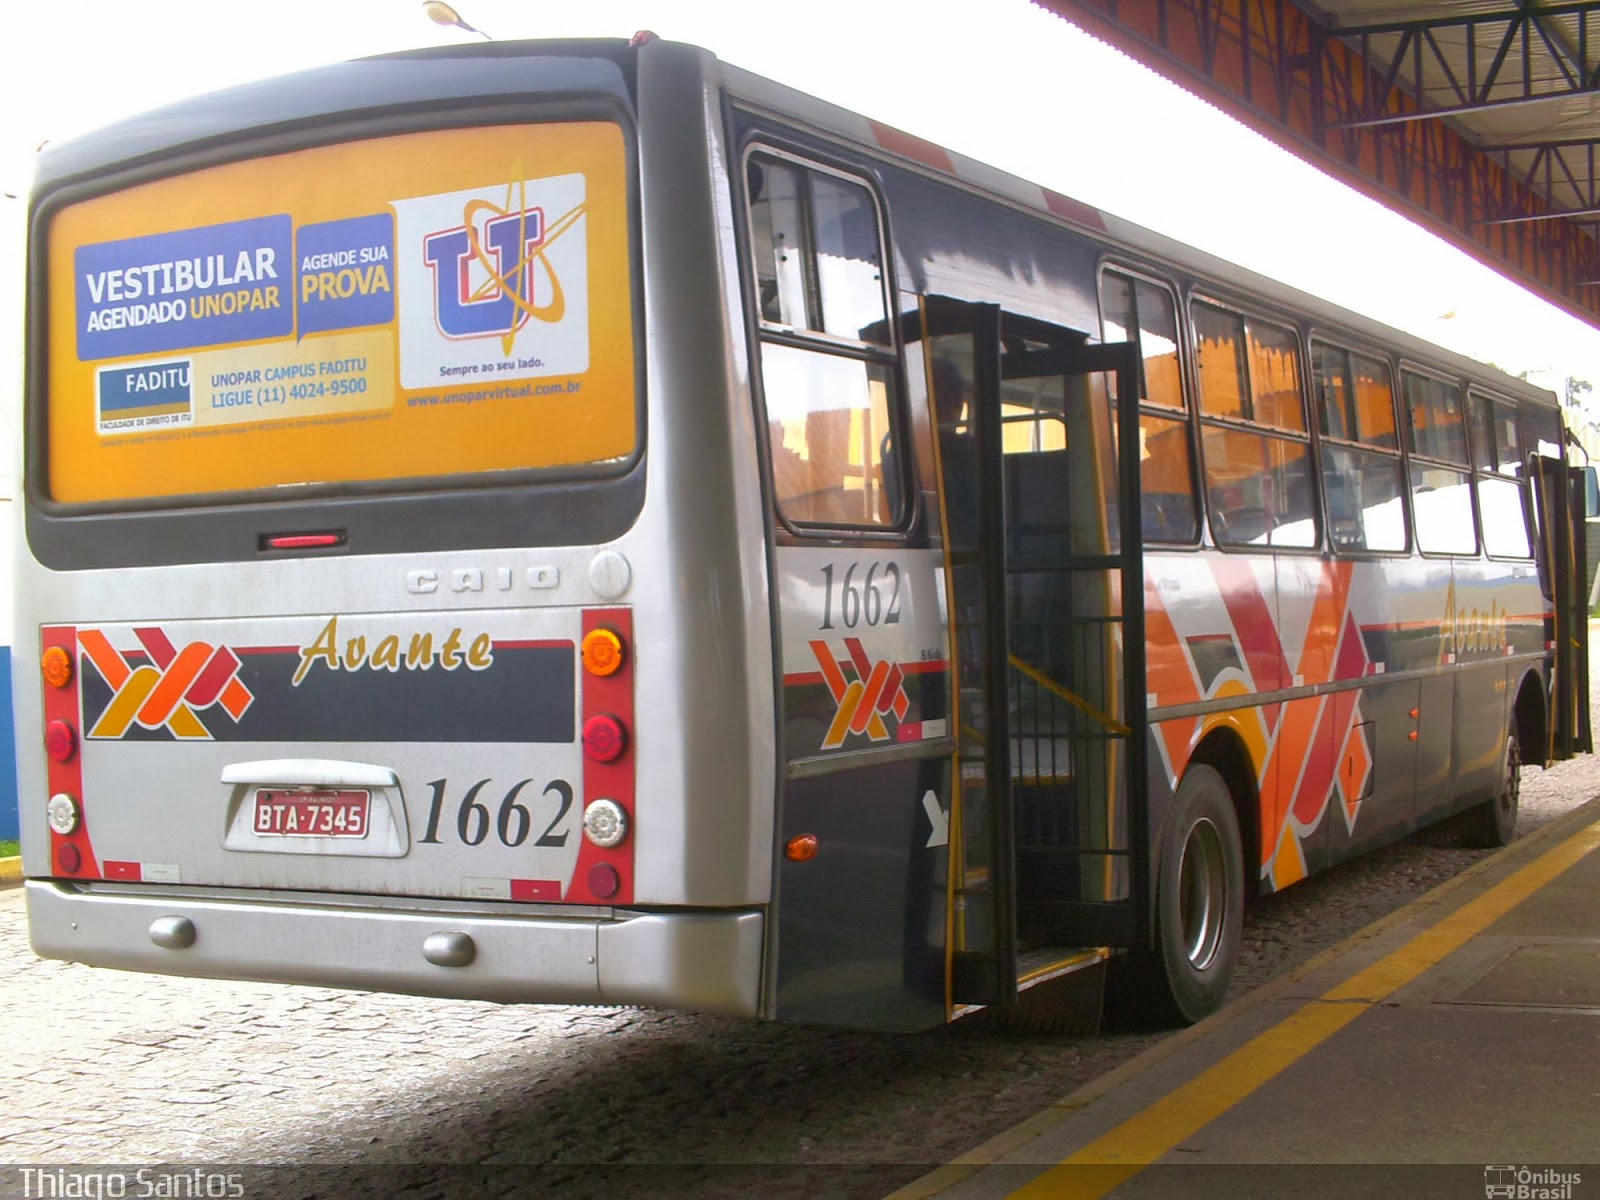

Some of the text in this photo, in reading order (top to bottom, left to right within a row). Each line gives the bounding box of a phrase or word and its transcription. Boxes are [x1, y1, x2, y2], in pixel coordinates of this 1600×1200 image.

[302, 246, 389, 272] AGENDE SUA
[86, 247, 278, 304] VESTIBULAR
[302, 265, 391, 303] PROVA
[87, 286, 280, 333] AGENDADO UNOPAR
[126, 366, 191, 393] FADITU
[211, 358, 367, 388] UNOPAR CAMPUS FADITU
[439, 357, 545, 377] Sempre ao seu lado.
[211, 378, 367, 408] LIGUE (11) 4024-9500
[407, 380, 582, 408] www.unoparvirtual.com.br
[100, 413, 192, 430] FACULDADE DE DIREITO DE ITU
[406, 565, 560, 595] CAIO
[818, 561, 901, 630] 1662
[292, 615, 493, 687] Avante
[417, 777, 575, 847] 1662
